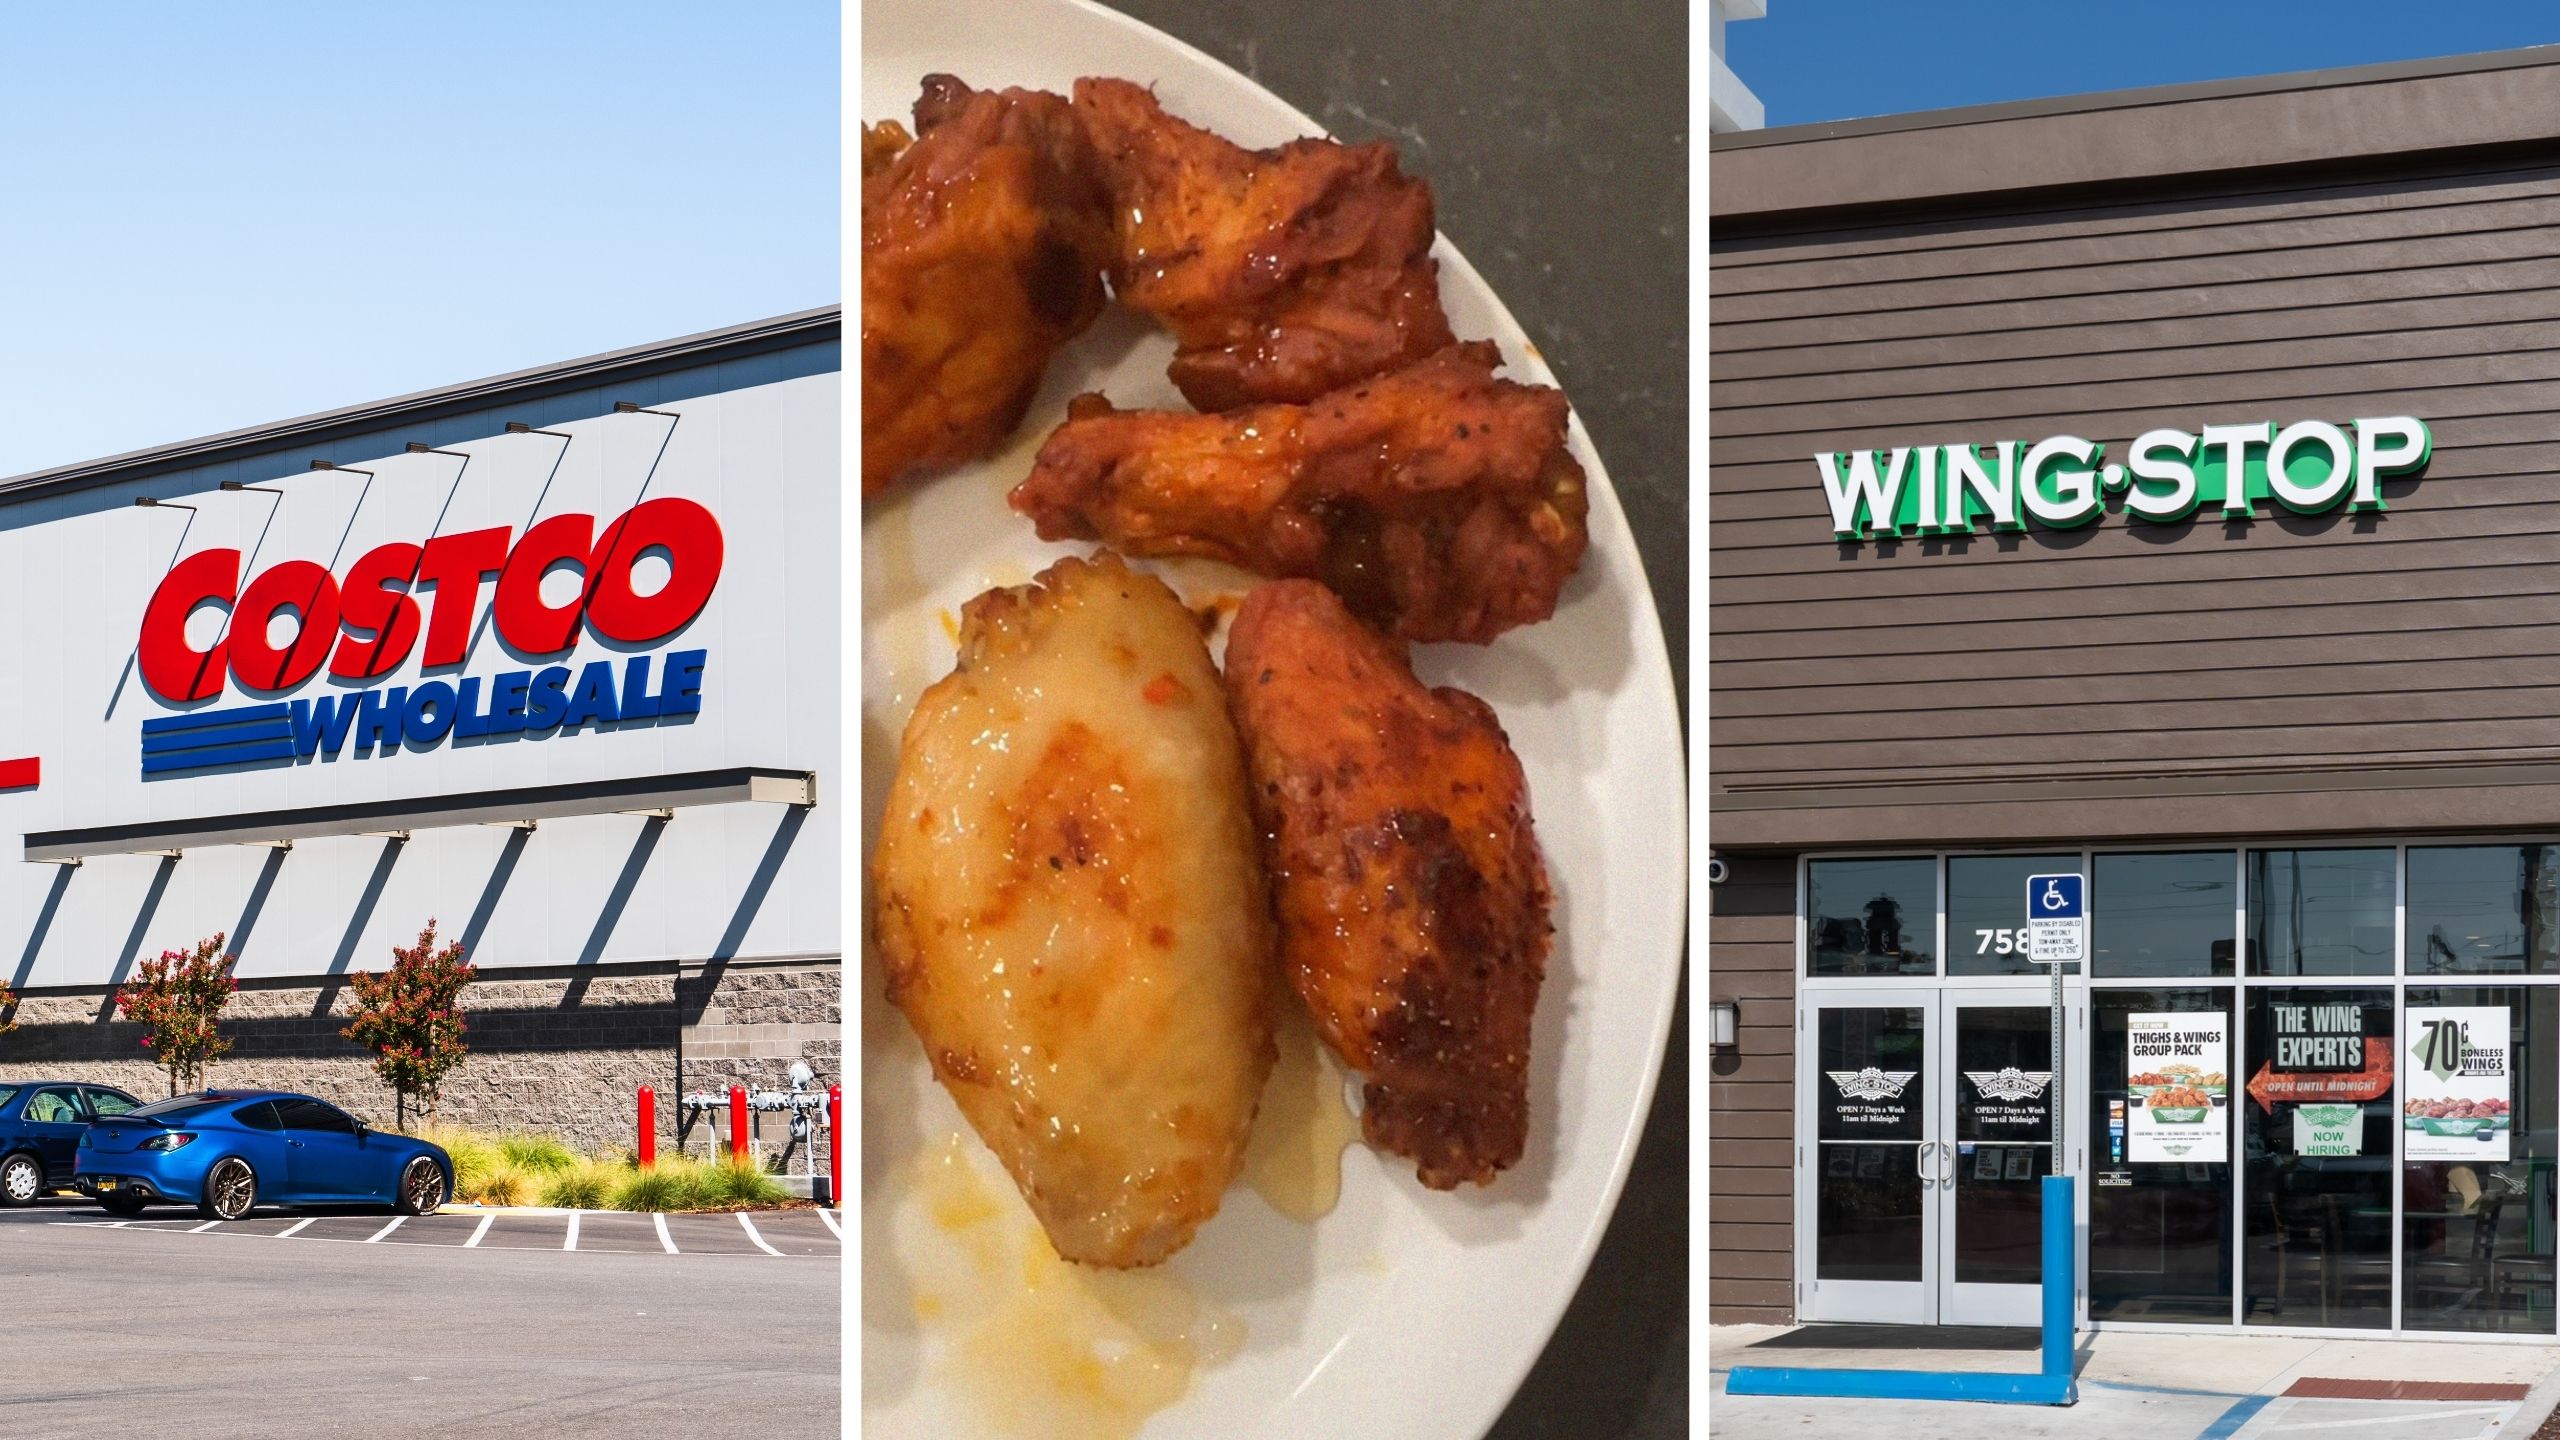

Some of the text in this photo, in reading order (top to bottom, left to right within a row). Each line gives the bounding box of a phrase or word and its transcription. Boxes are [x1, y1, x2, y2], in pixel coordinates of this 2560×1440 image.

[139, 497, 723, 701] COSTCO
[290, 649, 707, 756] WHOLESALE
[2275, 1005, 2361, 1033] THE WING
[2133, 1031, 2221, 1044] THIGHS & WINGS
[2133, 1044, 2202, 1056] GROUP PACK
[2278, 1037, 2361, 1066] EXPERTS
[2461, 1049, 2504, 1057] BONELESS
[2461, 1058, 2503, 1070] WINGS
[2267, 1081, 2377, 1092] OPEN UNTIL MIDNIGHT
[1865, 1106, 1881, 1115] Days
[1975, 1106, 1998, 1114] OPEN
[1999, 1106, 2003, 1114] 7
[2004, 1106, 2021, 1116] Days
[2027, 1106, 2046, 1114] Week
[1870, 1115, 1900, 1124] Midnight
[2009, 1115, 2040, 1125] Midnight
[2313, 1131, 2345, 1142] NOW
[2306, 1145, 2351, 1155] HIRING
